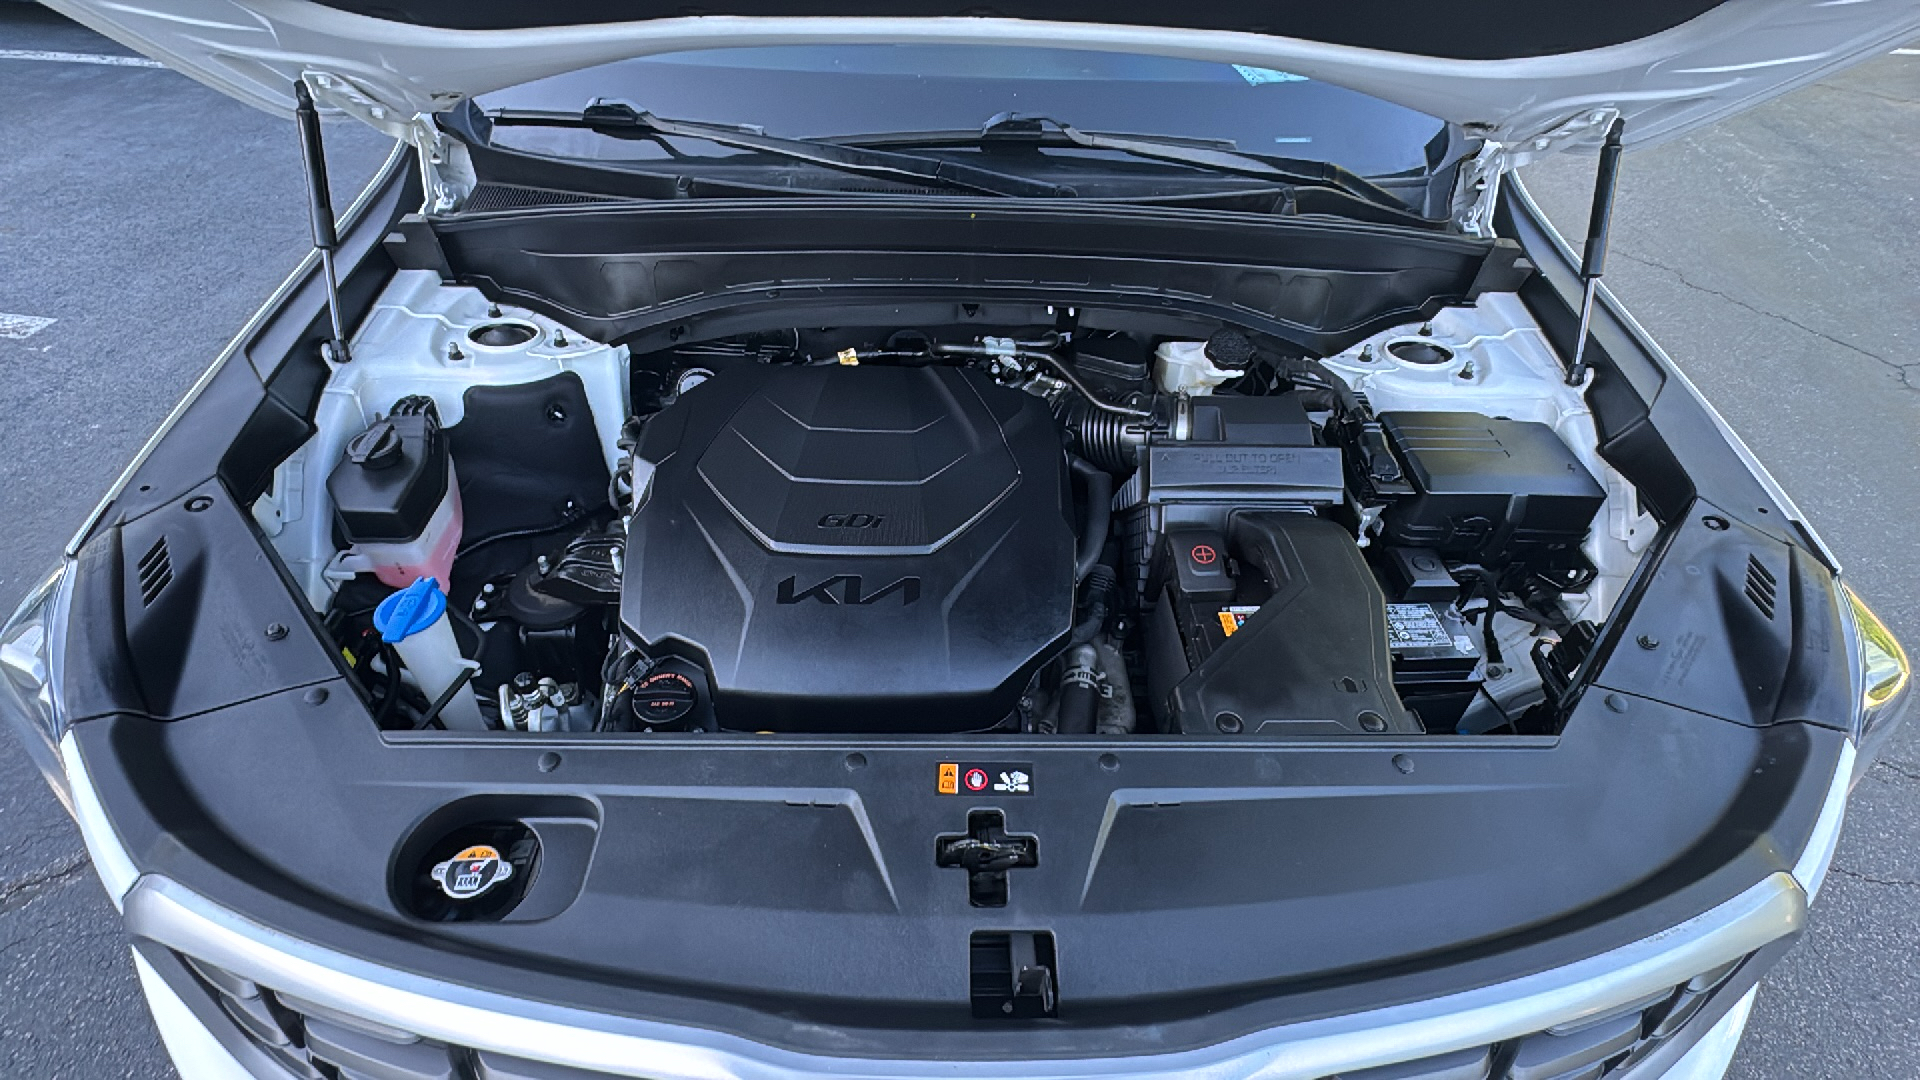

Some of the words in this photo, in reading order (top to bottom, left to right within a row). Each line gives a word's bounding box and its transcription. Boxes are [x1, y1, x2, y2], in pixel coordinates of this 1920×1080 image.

[1226, 453, 1248, 463] OUT
[1251, 453, 1267, 463] TO
[1270, 453, 1300, 464] OPEN
[817, 513, 885, 529] GDi
[776, 573, 921, 606] KIA
